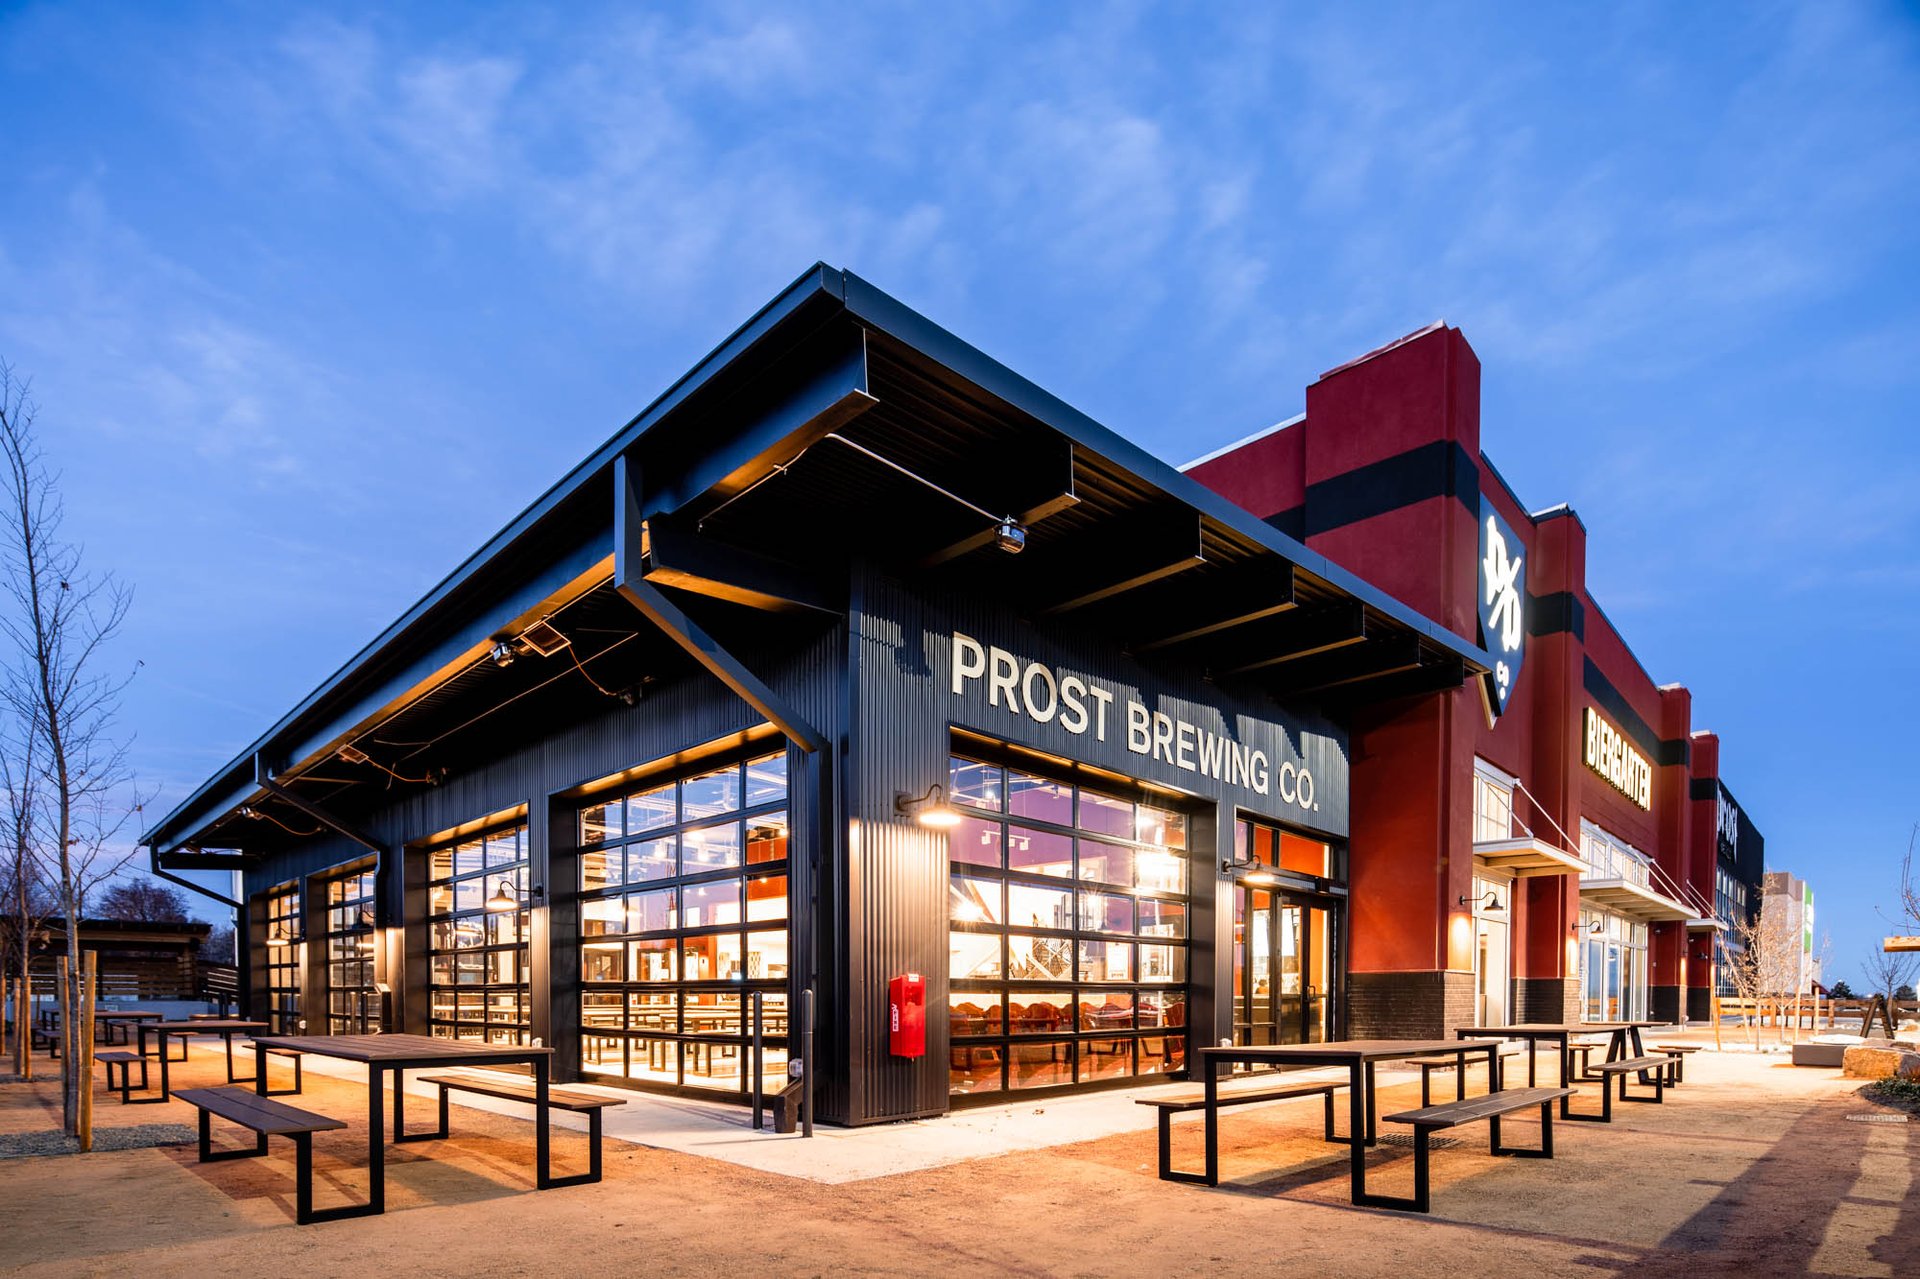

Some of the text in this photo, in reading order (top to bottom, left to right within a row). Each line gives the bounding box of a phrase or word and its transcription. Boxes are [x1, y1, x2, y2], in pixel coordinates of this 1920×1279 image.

[952, 631, 1318, 811] PROST BREWING CO.
[1587, 706, 1651, 811] BIERGARTEN
